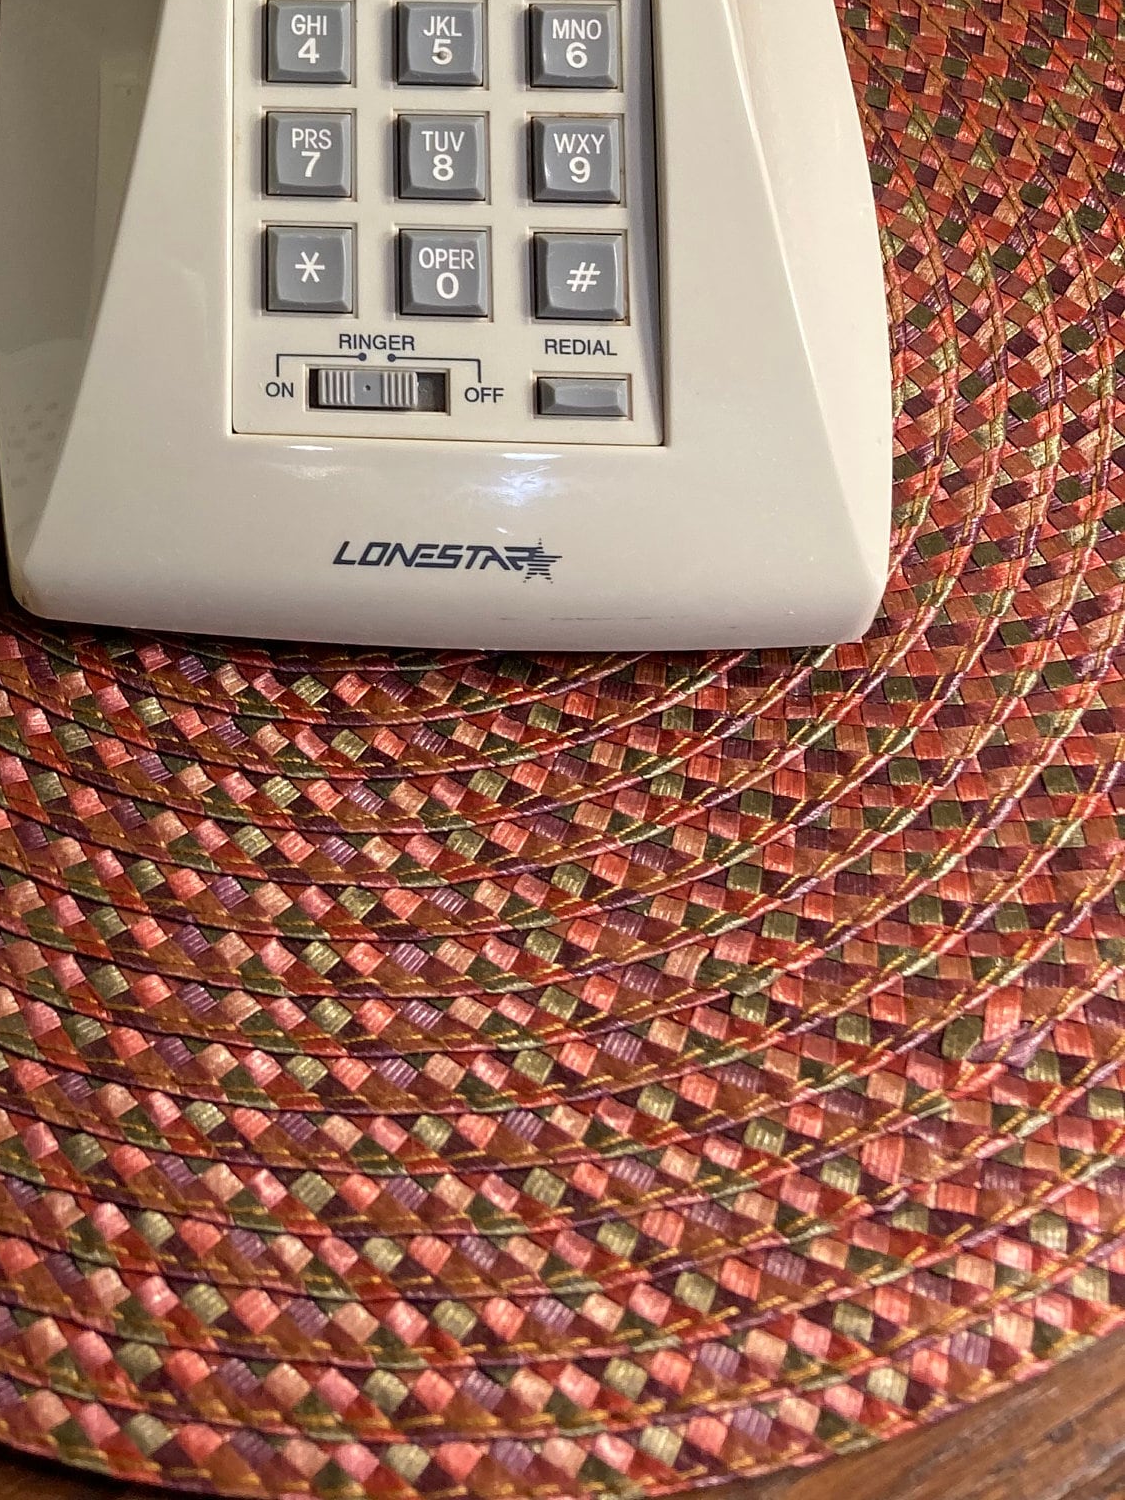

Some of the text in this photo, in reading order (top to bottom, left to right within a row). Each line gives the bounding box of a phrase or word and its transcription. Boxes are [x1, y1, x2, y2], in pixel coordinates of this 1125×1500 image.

[291, 14, 327, 36] GHI
[423, 15, 462, 37] JKL
[552, 18, 602, 40] MNO
[297, 37, 320, 64] 4
[431, 38, 453, 65] 5
[565, 41, 588, 69] 6
[291, 127, 332, 150] PRS
[421, 130, 465, 152] TUV
[553, 133, 605, 154] WXY
[301, 150, 321, 178] 7
[432, 153, 454, 182] 8
[569, 156, 591, 183] 9
[418, 247, 475, 270] OPER
[436, 272, 459, 299] 0
[339, 333, 415, 351] RINGER
[544, 338, 618, 356] REDIAL
[265, 381, 294, 398] ON
[464, 386, 504, 404] OFF
[332, 539, 538, 572] LONESTAR
